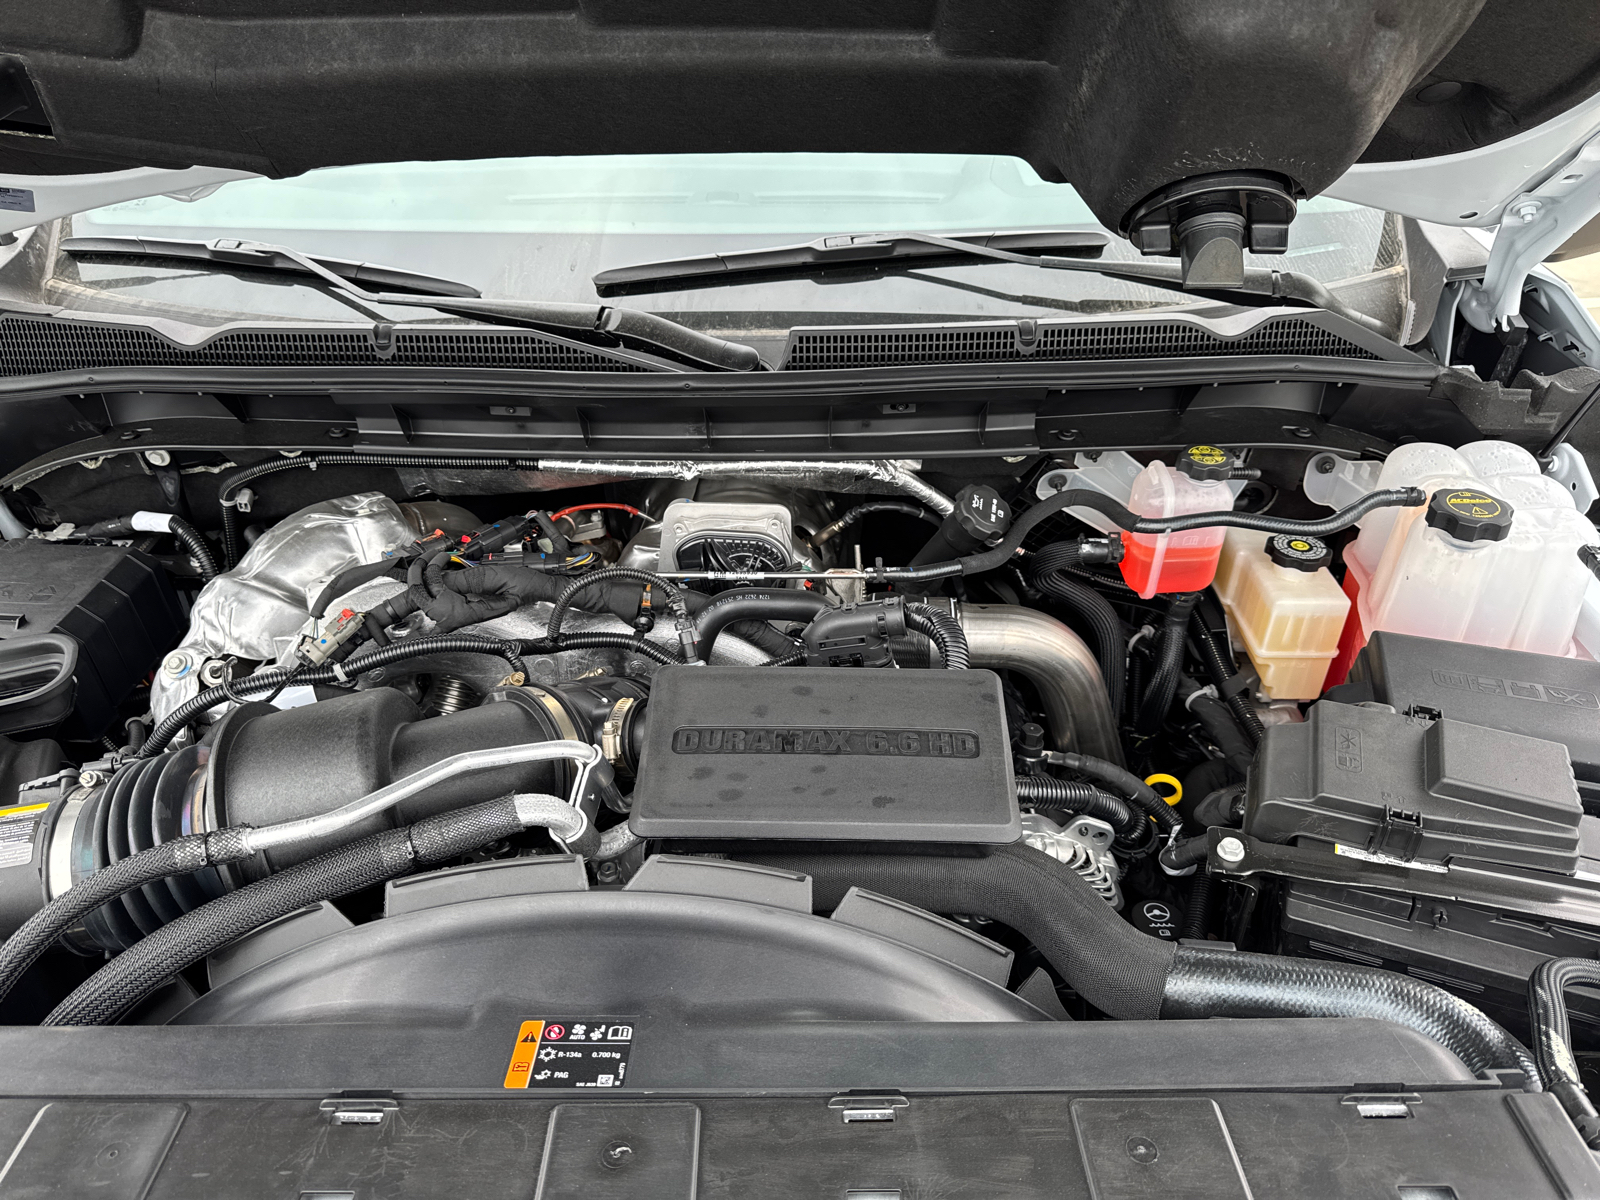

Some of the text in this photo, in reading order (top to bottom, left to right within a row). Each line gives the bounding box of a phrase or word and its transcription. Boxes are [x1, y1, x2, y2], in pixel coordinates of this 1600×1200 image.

[676, 728, 978, 757] DURAMAX 6.6 HD
[611, 1051, 621, 1059] kg
[553, 1071, 569, 1079] PAG
